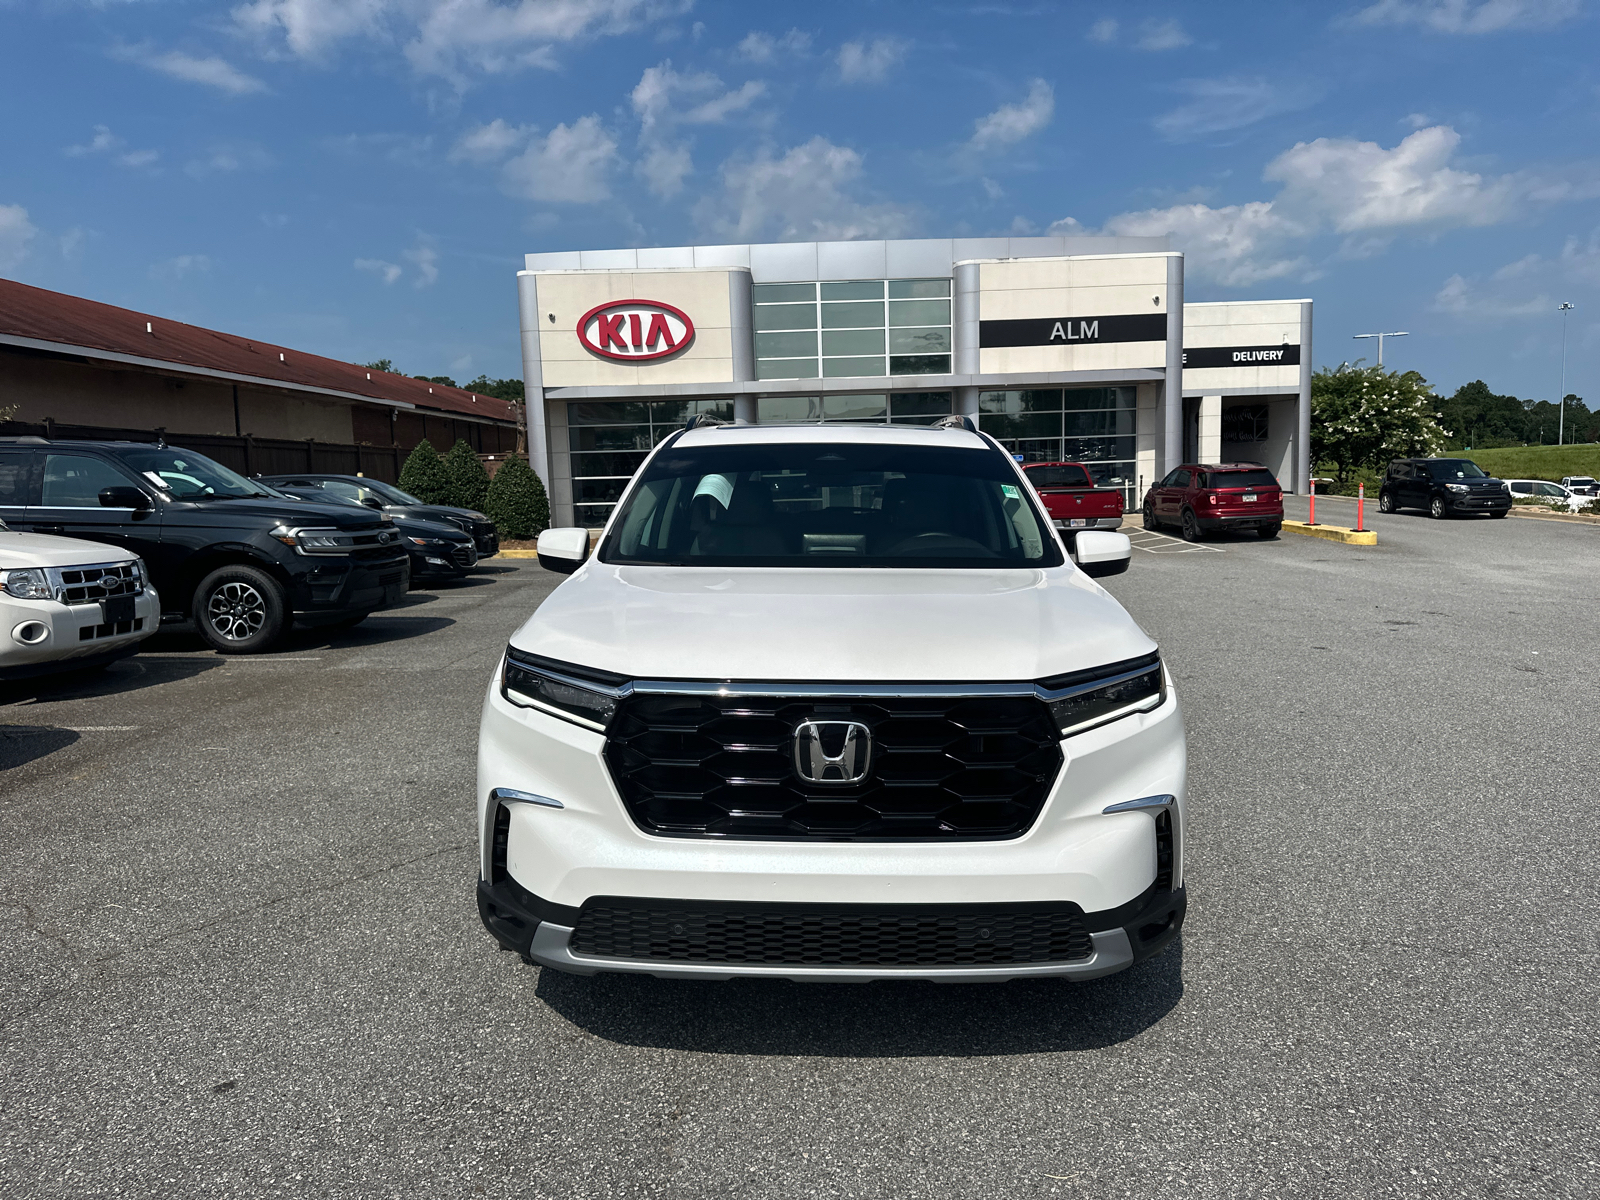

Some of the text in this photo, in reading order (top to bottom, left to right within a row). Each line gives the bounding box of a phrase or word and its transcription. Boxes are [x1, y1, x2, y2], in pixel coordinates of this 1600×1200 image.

[596, 313, 676, 347] KIA
[1049, 320, 1099, 340] ALM
[1232, 350, 1284, 362] DELIVERY
